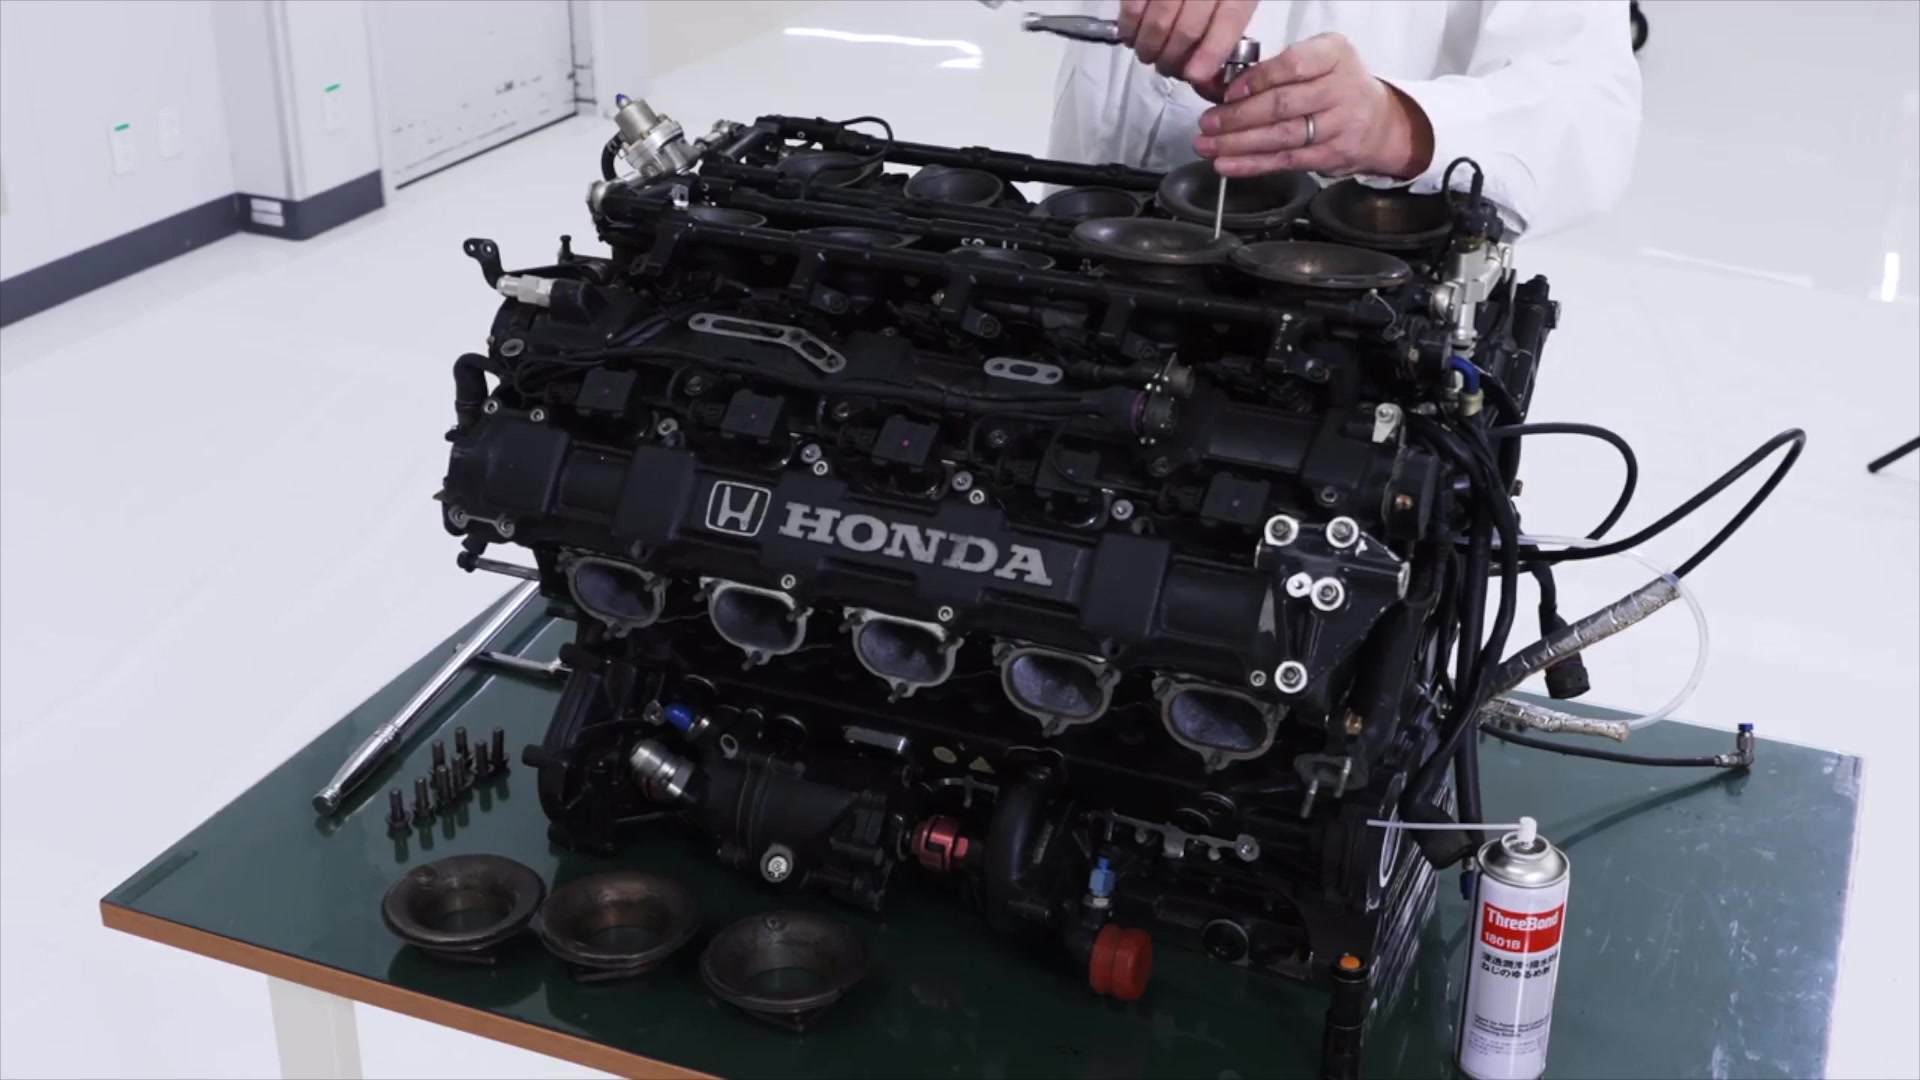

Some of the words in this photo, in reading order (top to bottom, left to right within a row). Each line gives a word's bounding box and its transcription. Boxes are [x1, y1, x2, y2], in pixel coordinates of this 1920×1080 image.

[778, 502, 1053, 586] HONDA
[1486, 906, 1560, 931] ThreeBond
[1484, 931, 1521, 950] 1801B
